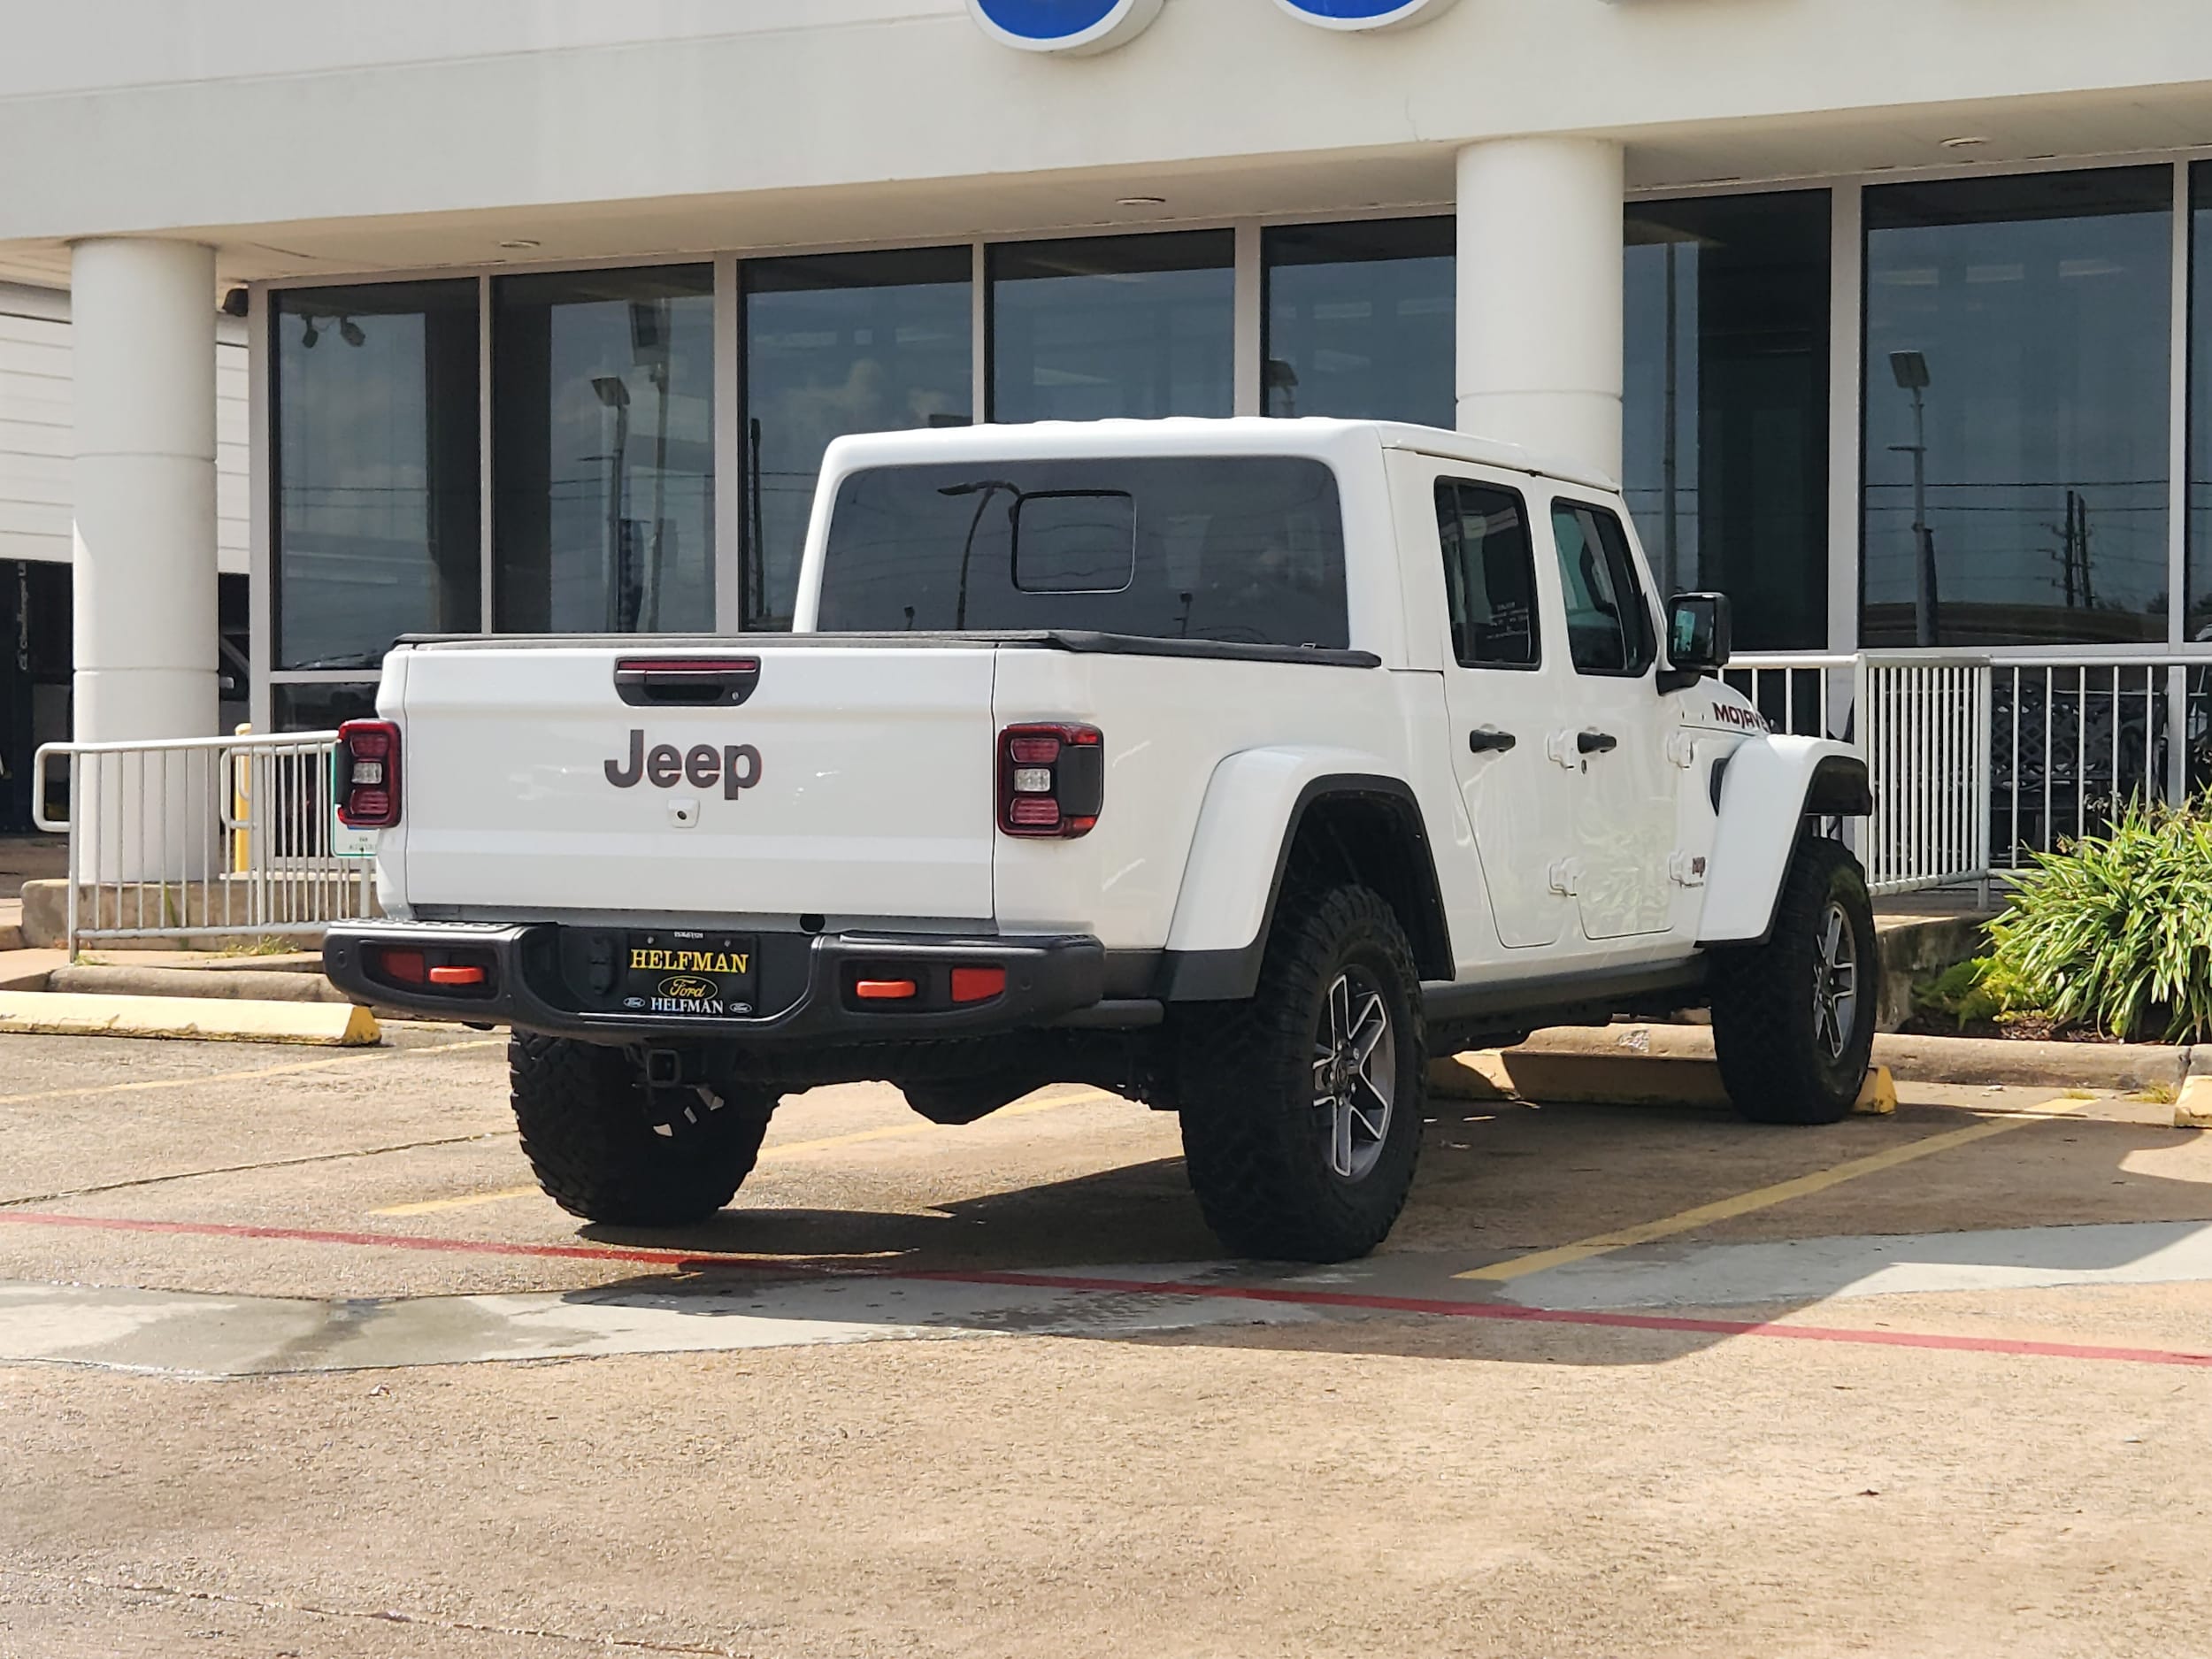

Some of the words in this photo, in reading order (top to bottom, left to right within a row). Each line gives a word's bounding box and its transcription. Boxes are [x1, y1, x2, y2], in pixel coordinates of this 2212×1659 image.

[604, 729, 762, 800] Jeep
[630, 949, 749, 973] HELFMAN
[670, 978, 706, 997] Ford
[650, 996, 723, 1014] HELFMAN
